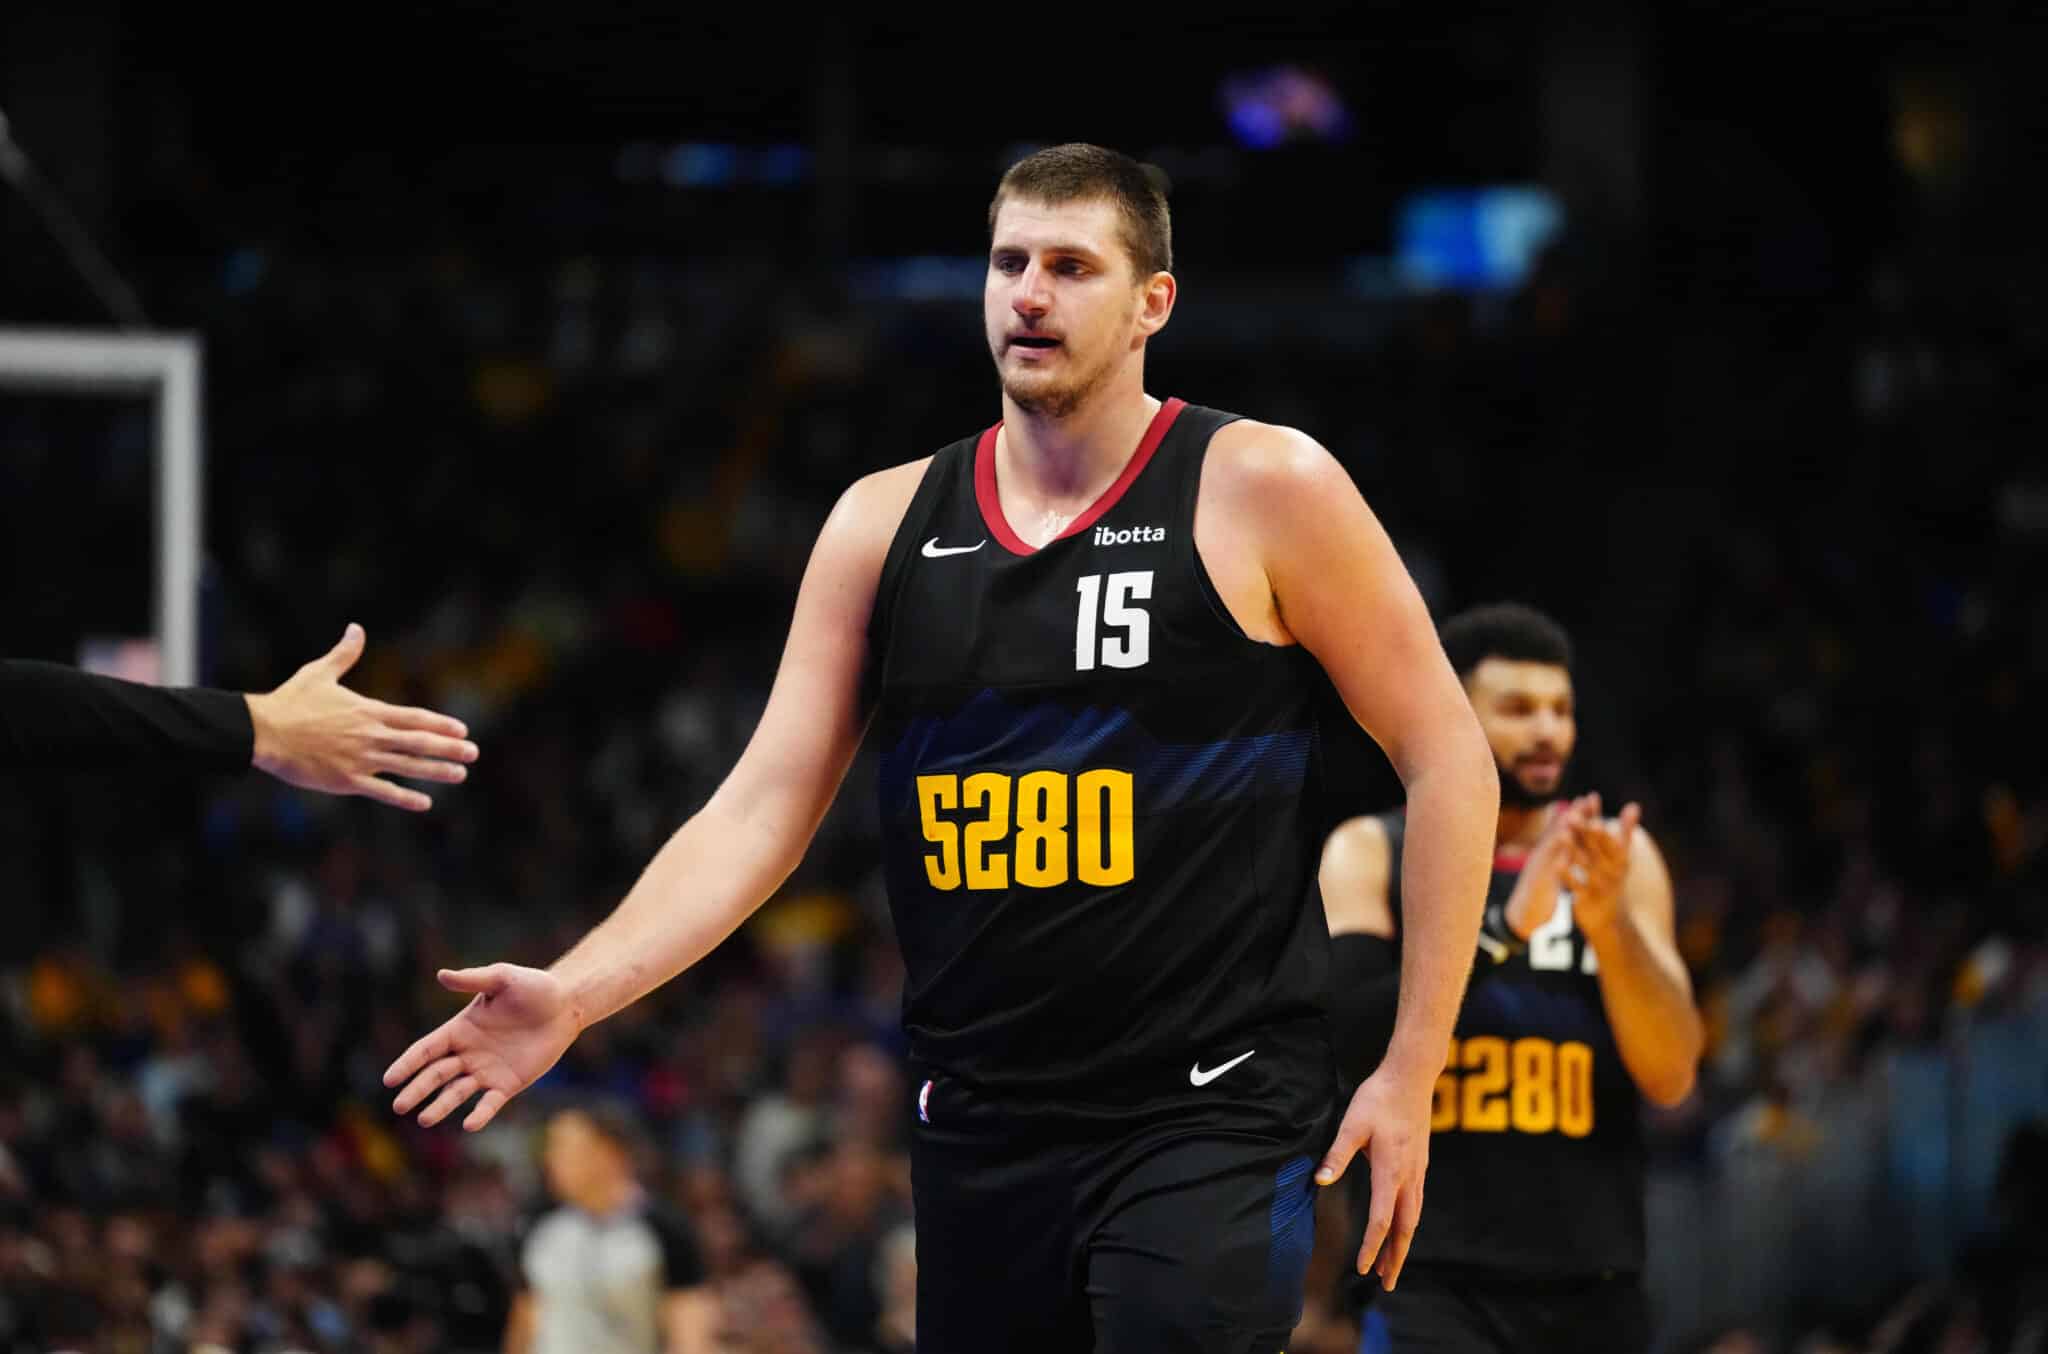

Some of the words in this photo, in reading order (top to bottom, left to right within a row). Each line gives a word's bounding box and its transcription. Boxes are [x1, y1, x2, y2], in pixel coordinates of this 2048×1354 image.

[1094, 527, 1165, 545] ibotta
[1075, 570, 1154, 671] 15
[916, 768, 1135, 890] 5280
[1529, 892, 1598, 974] 2
